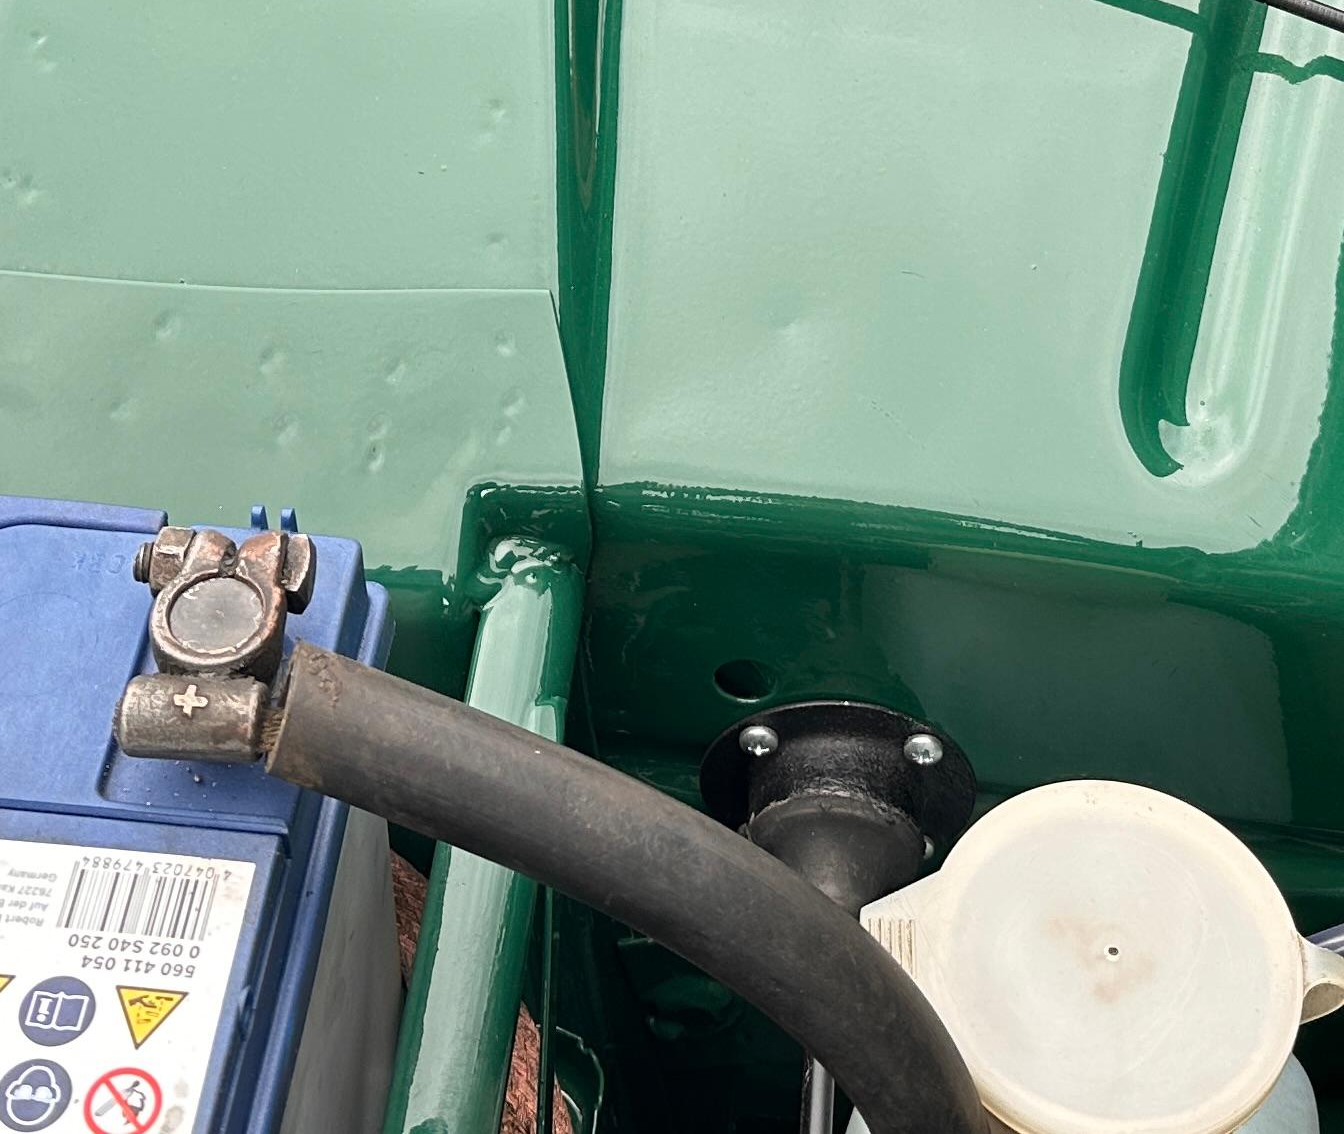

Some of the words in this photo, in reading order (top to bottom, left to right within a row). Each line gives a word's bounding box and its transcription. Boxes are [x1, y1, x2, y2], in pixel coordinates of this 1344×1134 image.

[81, 855, 144, 872] 479884
[151, 861, 215, 878] 047023
[7, 868, 58, 882] Germany
[224, 869, 232, 881] 4
[18, 885, 54, 897] 76227
[8, 899, 27, 910] der
[28, 901, 49, 911] Auf
[5, 914, 45, 927] Robert
[68, 933, 103, 950] 250
[109, 937, 144, 953] S40
[149, 941, 184, 957] 092
[189, 945, 201, 959] 0
[81, 954, 116, 971] 054
[123, 958, 155, 975] 411
[160, 961, 196, 978] 560
